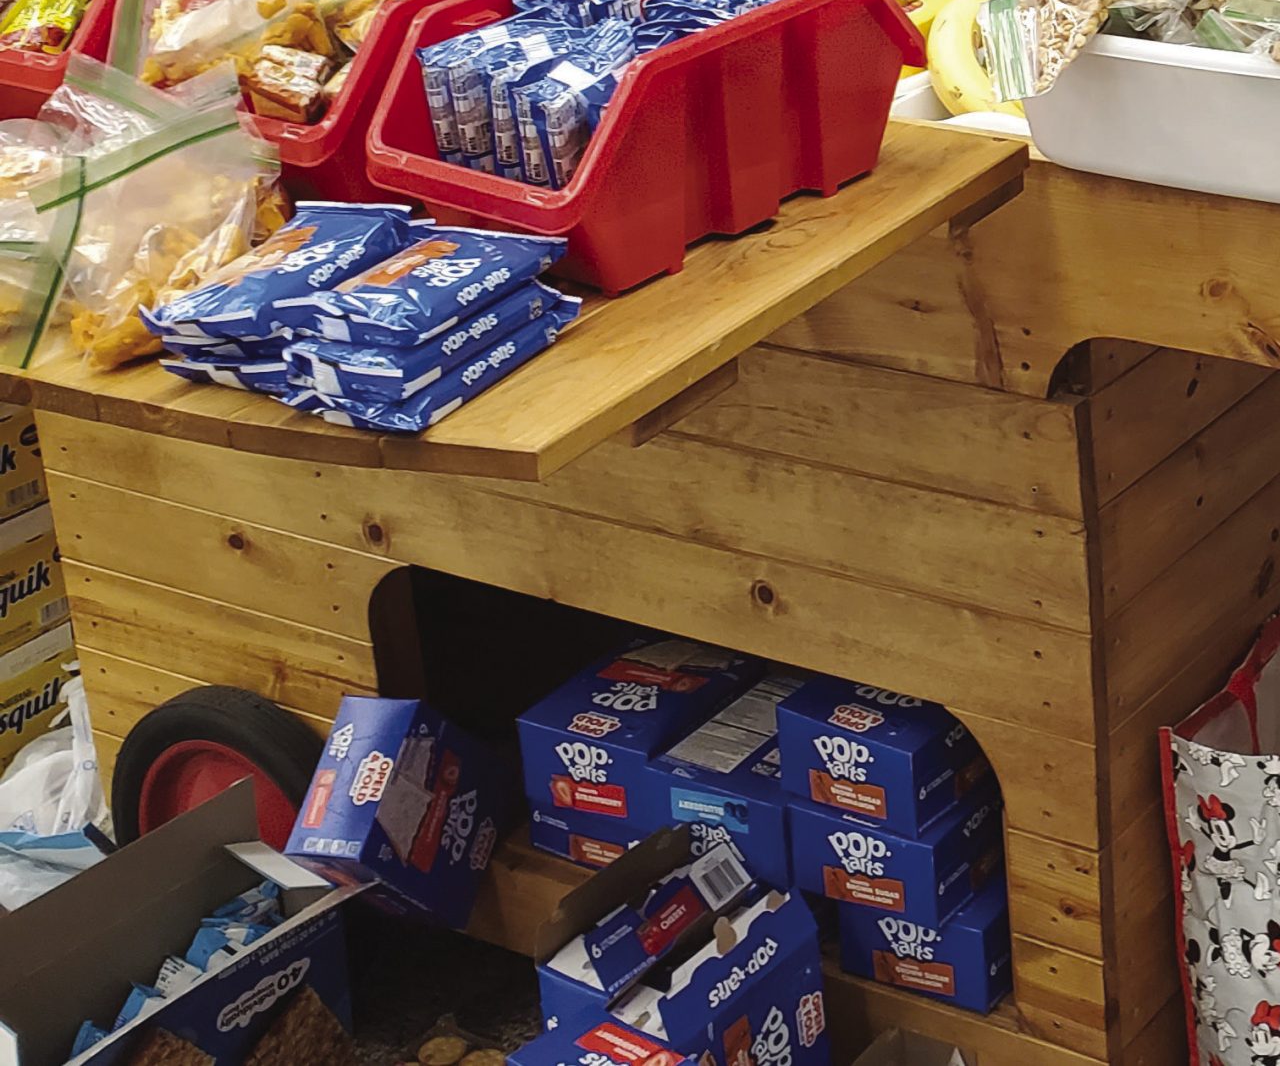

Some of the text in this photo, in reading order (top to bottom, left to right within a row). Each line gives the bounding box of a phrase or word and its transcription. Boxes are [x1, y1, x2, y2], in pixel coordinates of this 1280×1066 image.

[568, 764, 608, 783] tarts
[826, 759, 868, 782] tarts
[841, 855, 885, 876] tarts
[890, 940, 934, 961] tarts
[276, 966, 303, 990] 40
